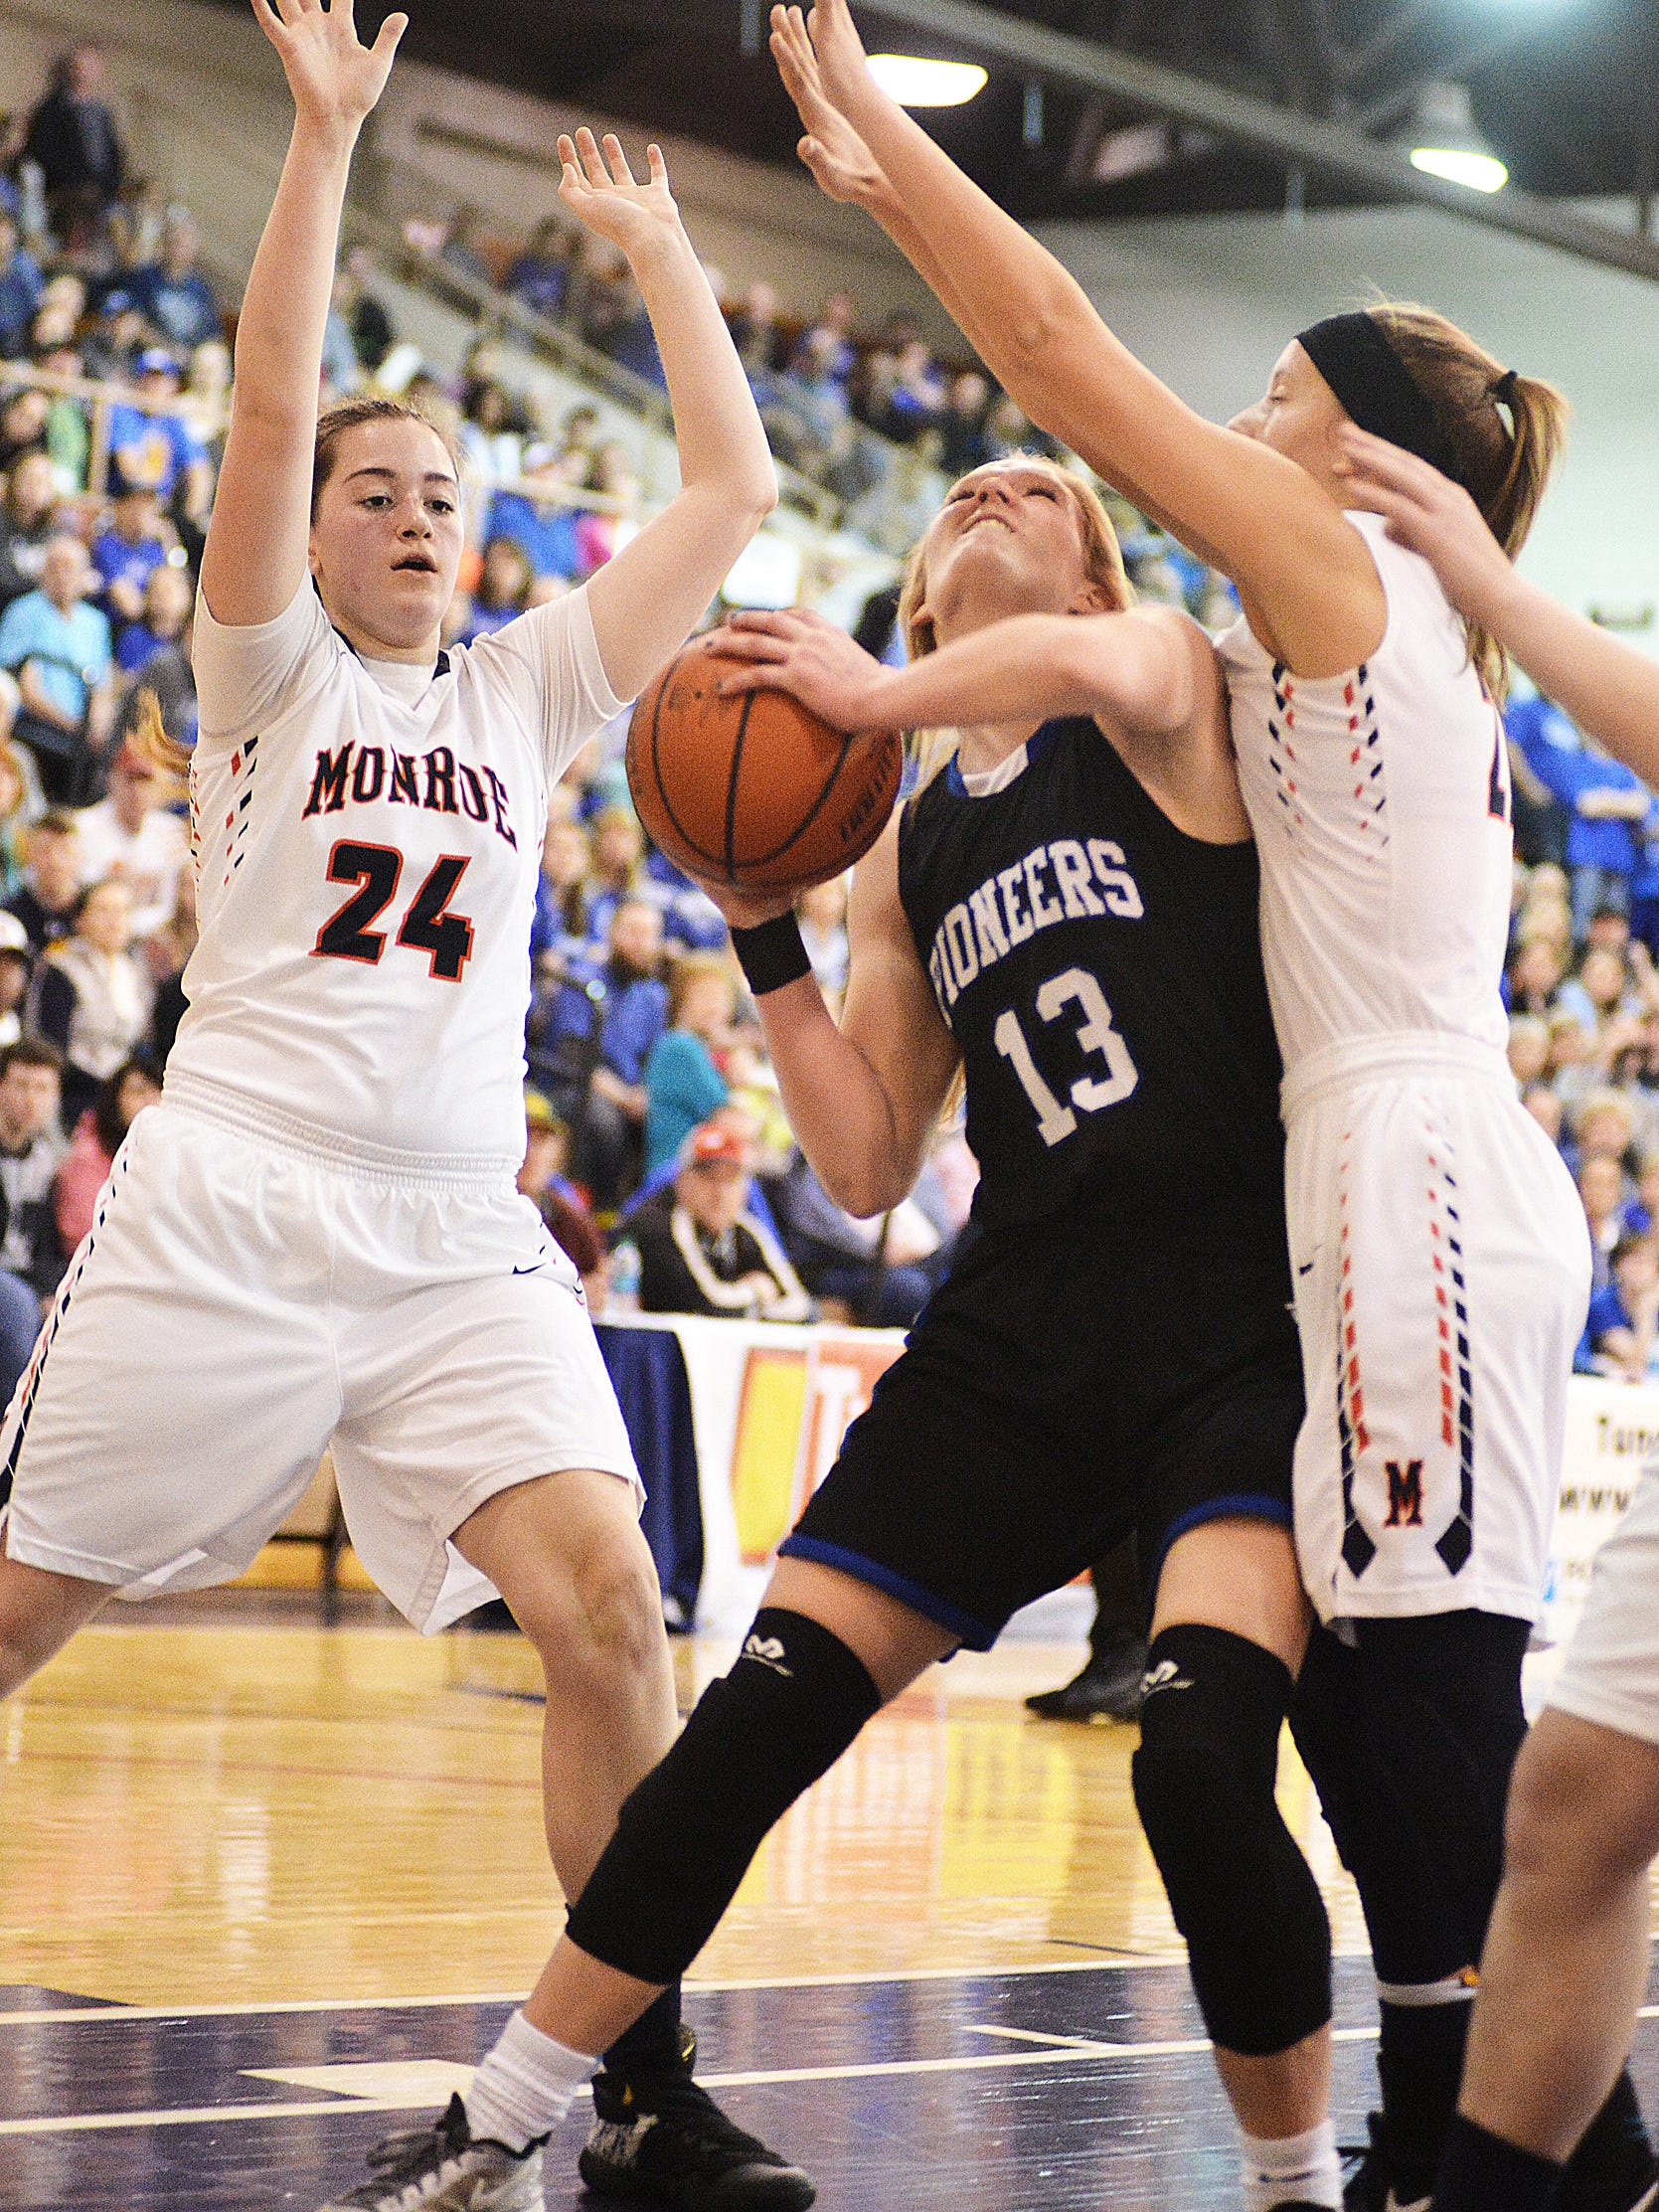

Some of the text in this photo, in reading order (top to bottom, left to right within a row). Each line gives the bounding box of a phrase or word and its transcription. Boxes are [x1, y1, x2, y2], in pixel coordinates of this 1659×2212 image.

[301, 740, 517, 852] MONROE
[308, 838, 475, 983] 24
[928, 837, 1144, 1031] PIONEERS
[994, 966, 1139, 1147] 13
[1384, 1459, 1423, 1528] M
